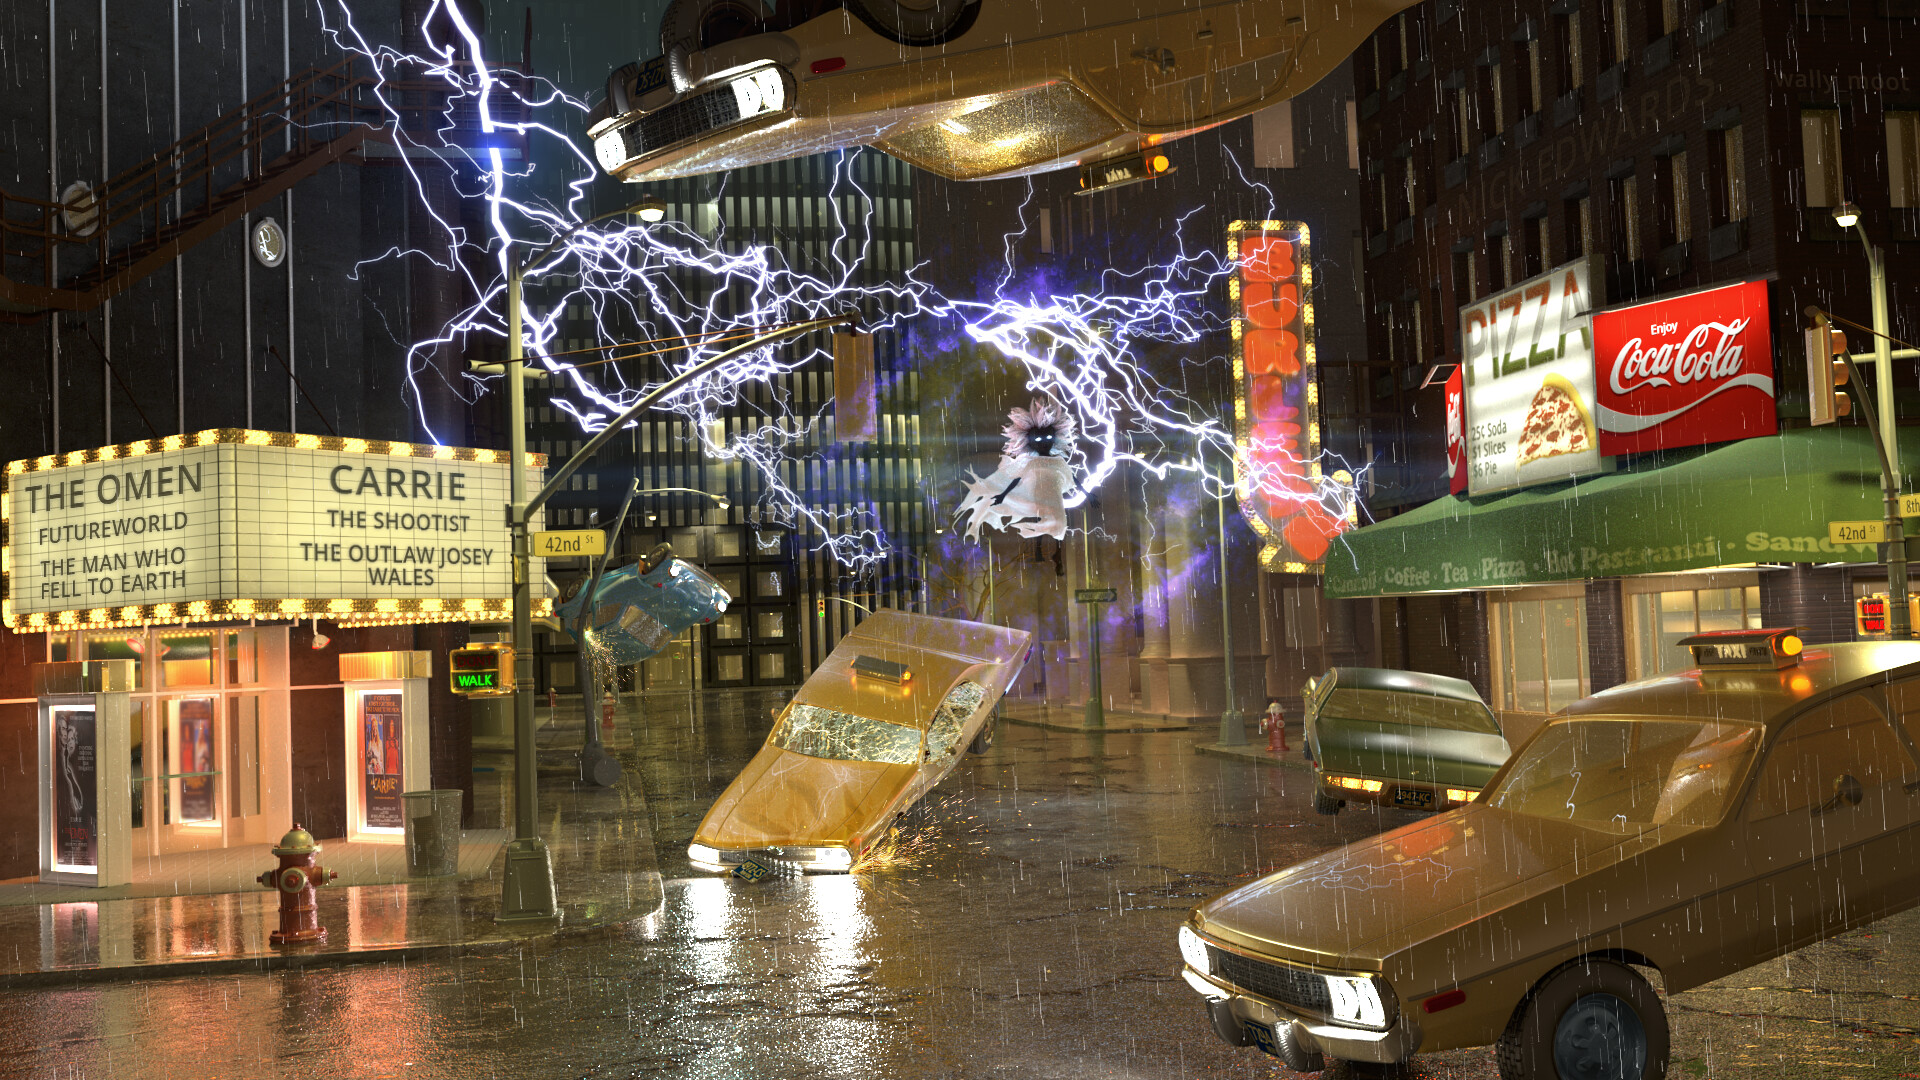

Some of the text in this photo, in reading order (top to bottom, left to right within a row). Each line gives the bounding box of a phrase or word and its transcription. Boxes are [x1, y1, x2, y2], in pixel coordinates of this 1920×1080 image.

[1465, 269, 1591, 387] PIZZA
[1650, 322, 1678, 336] Enjoy
[1609, 316, 1751, 395] Coca-Cola
[1487, 419, 1507, 438] Soda
[1473, 441, 1507, 459] $1 Slices
[1474, 461, 1498, 479] $6 Pie
[25, 461, 203, 514] THE OMEN
[330, 465, 467, 501] CARRIE
[38, 511, 188, 546] FUTUREWORLD
[327, 509, 470, 533] THE SHOOTIST
[1838, 524, 1876, 541] 42nd St
[545, 534, 594, 552] 42nd St
[40, 546, 186, 578] THE MAN WHO
[300, 542, 493, 570] THE OUTLAW JOSEY
[1384, 567, 1430, 587] Coffee
[1441, 561, 1469, 584] Tea
[1482, 557, 1527, 580] Pizza
[1546, 549, 1577, 574] Hot
[1580, 536, 1717, 571] Pastrami
[40, 569, 187, 600] FELL TO EARTH
[368, 567, 435, 587] WALES
[1714, 643, 1747, 659] TAXI
[458, 674, 493, 687] WALK
